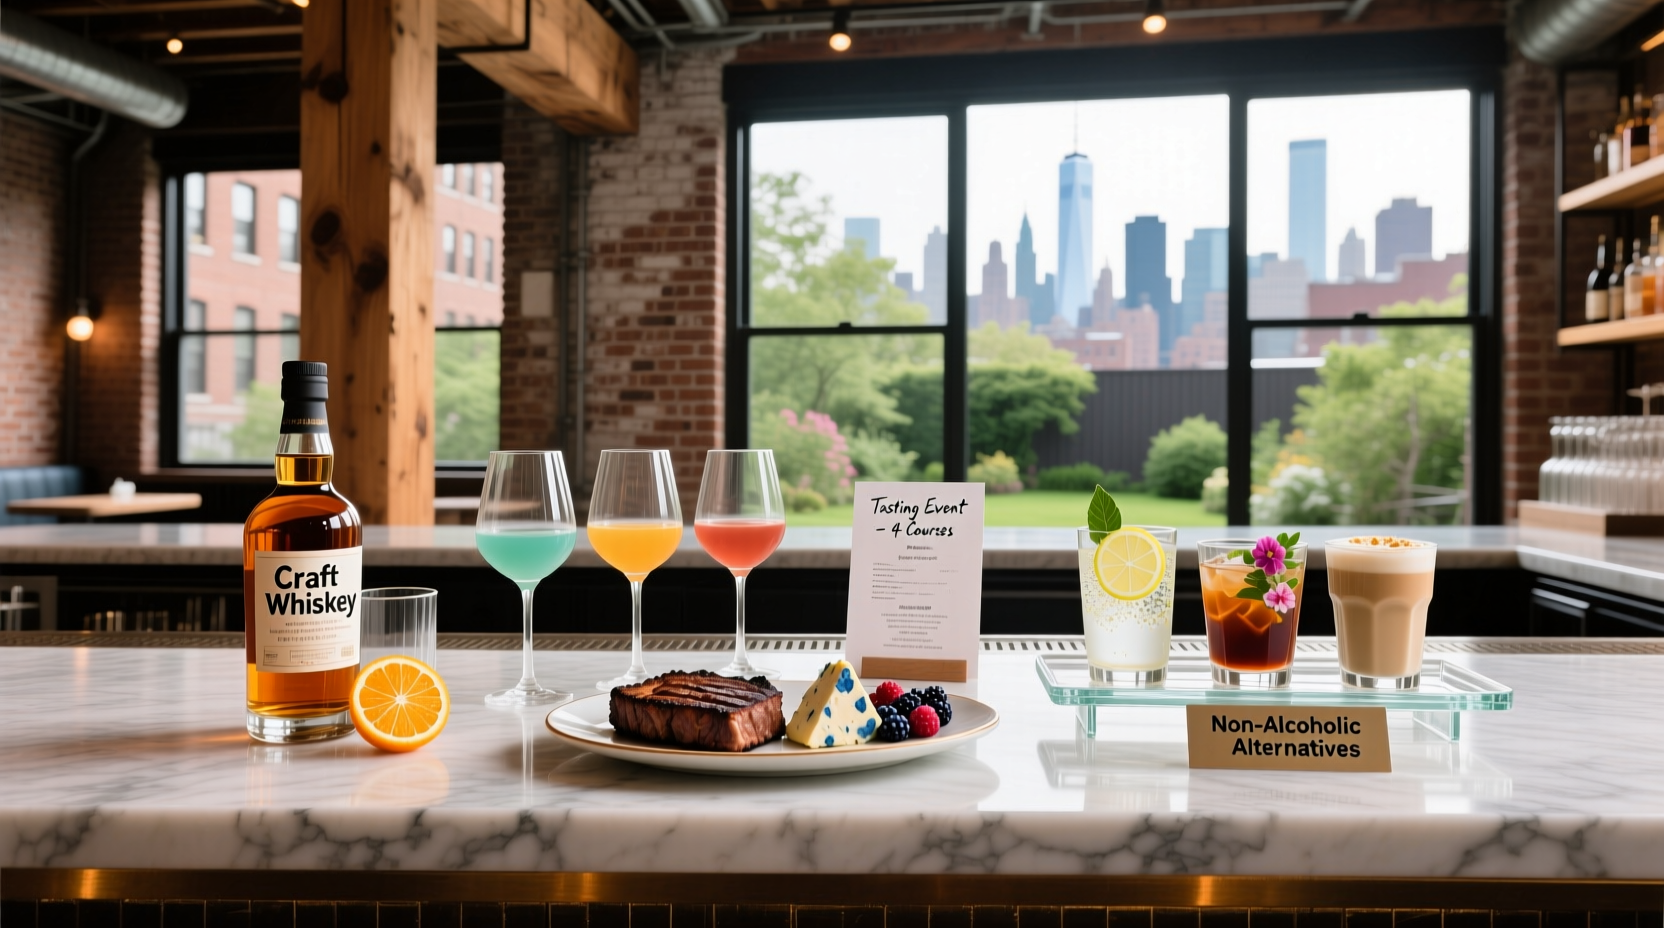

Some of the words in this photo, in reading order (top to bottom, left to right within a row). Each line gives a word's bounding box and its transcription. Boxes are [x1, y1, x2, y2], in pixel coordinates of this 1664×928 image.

[871, 496, 919, 520] Tasting
[924, 497, 969, 514] Event
[891, 522, 902, 538] 4
[906, 520, 953, 537] Courses
[274, 563, 339, 589] Craft
[265, 591, 357, 618] Whiskey
[1211, 715, 1361, 734] Non-Alcoholic
[1232, 738, 1361, 758] Alternatives
